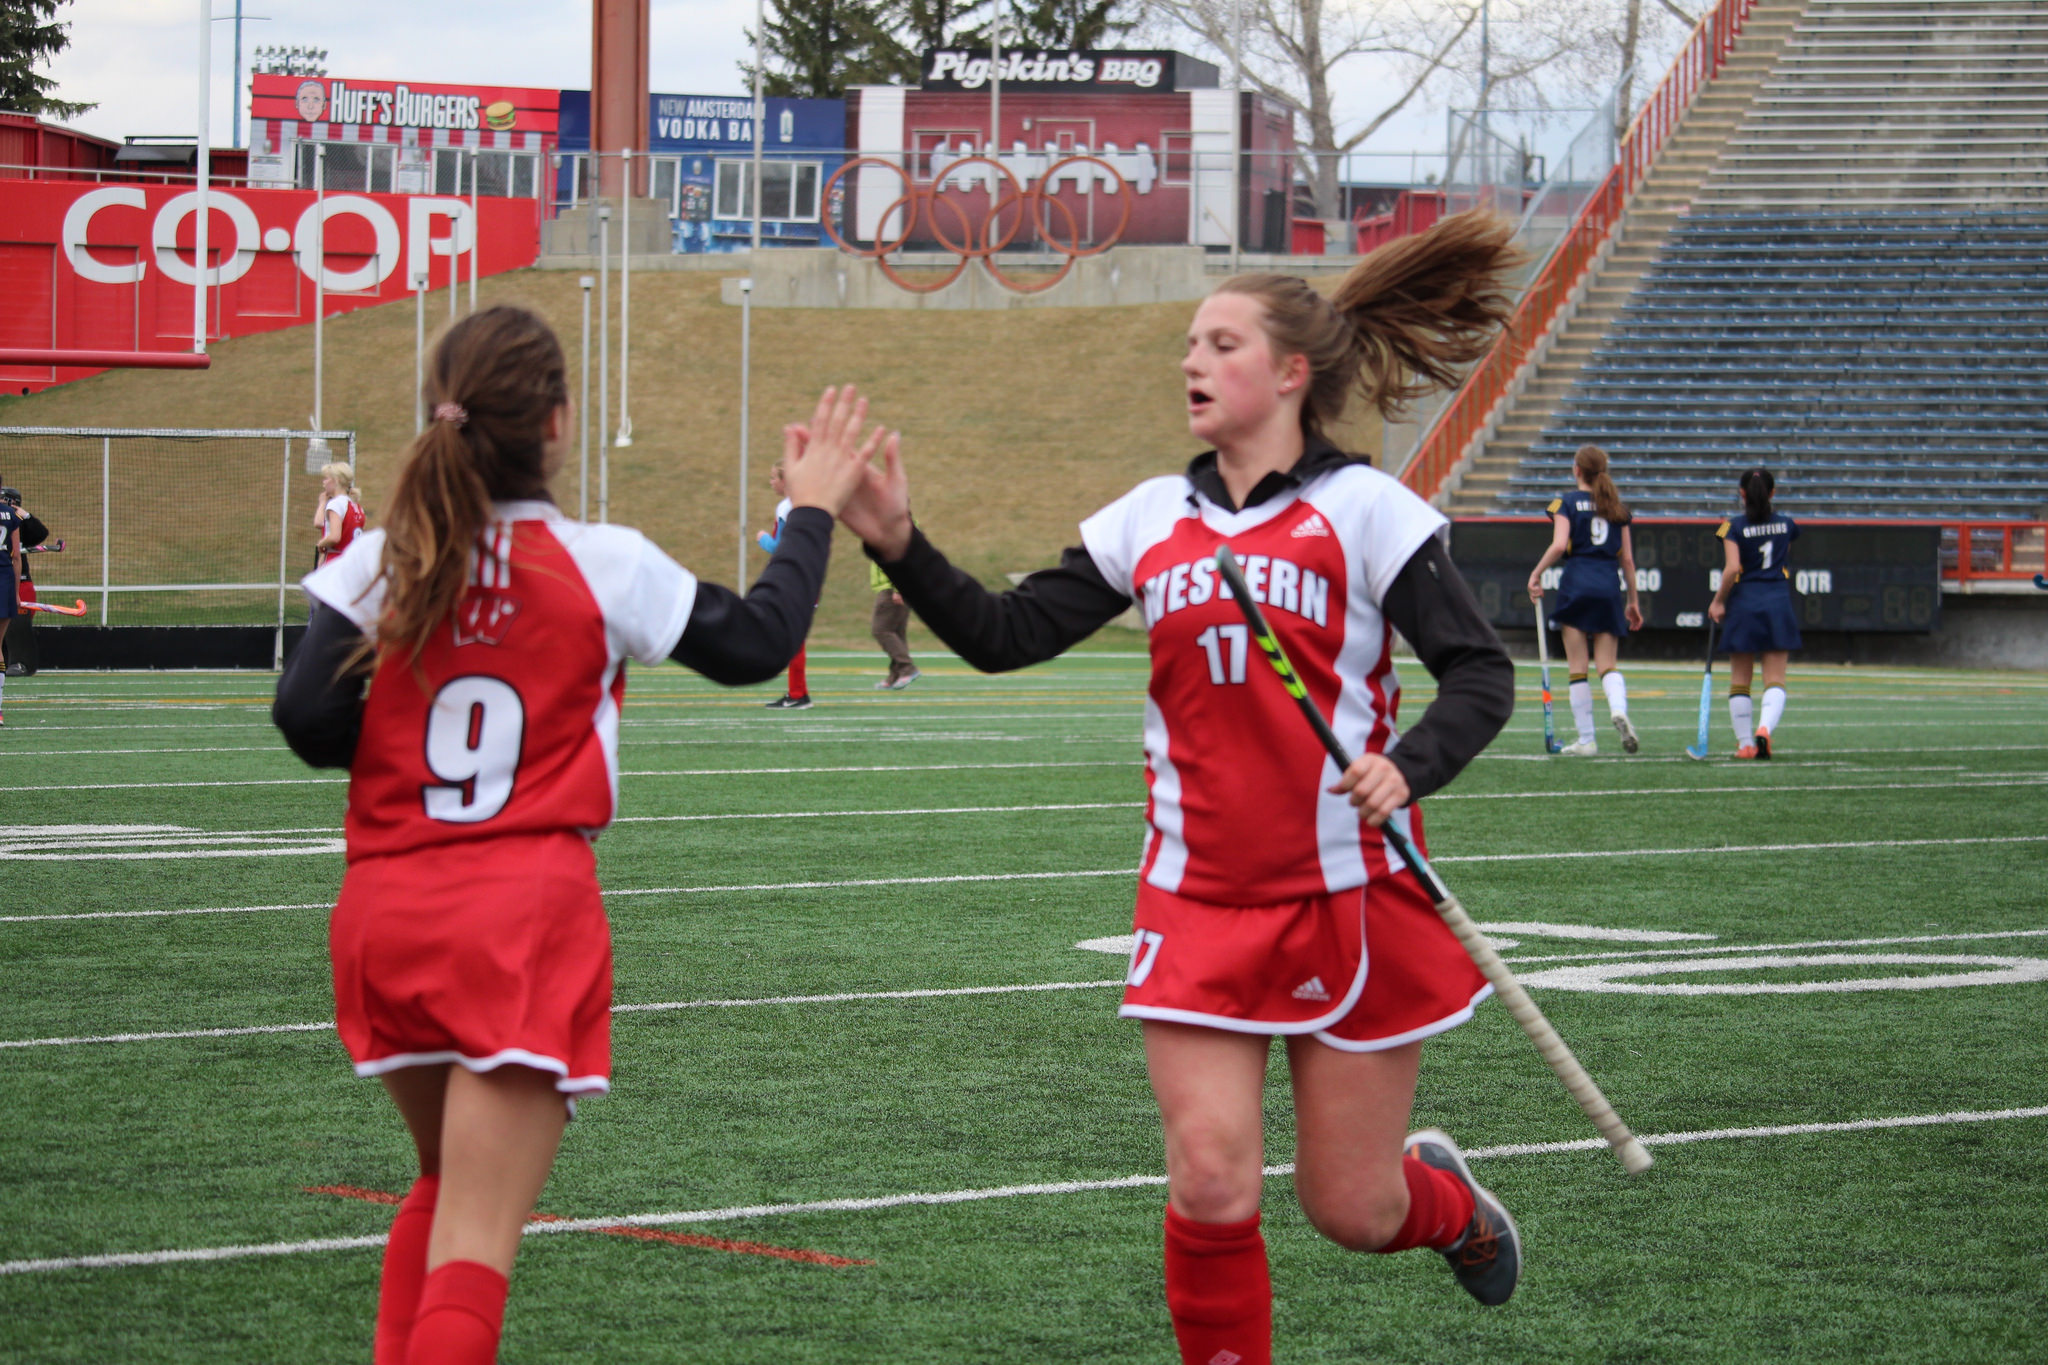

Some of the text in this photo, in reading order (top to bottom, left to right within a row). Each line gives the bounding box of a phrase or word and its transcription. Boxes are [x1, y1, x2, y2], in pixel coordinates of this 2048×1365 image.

[928, 51, 1163, 89] Pigskin's BBQ
[330, 81, 481, 130] HUFF'S BURGERS
[658, 99, 686, 117] NEW
[658, 117, 764, 142] VODKA BA
[1590, 516, 1609, 546] 9
[1759, 540, 1774, 569] 1
[1795, 569, 1832, 595] QTR
[1196, 623, 1249, 685] 17
[423, 675, 525, 824] 9
